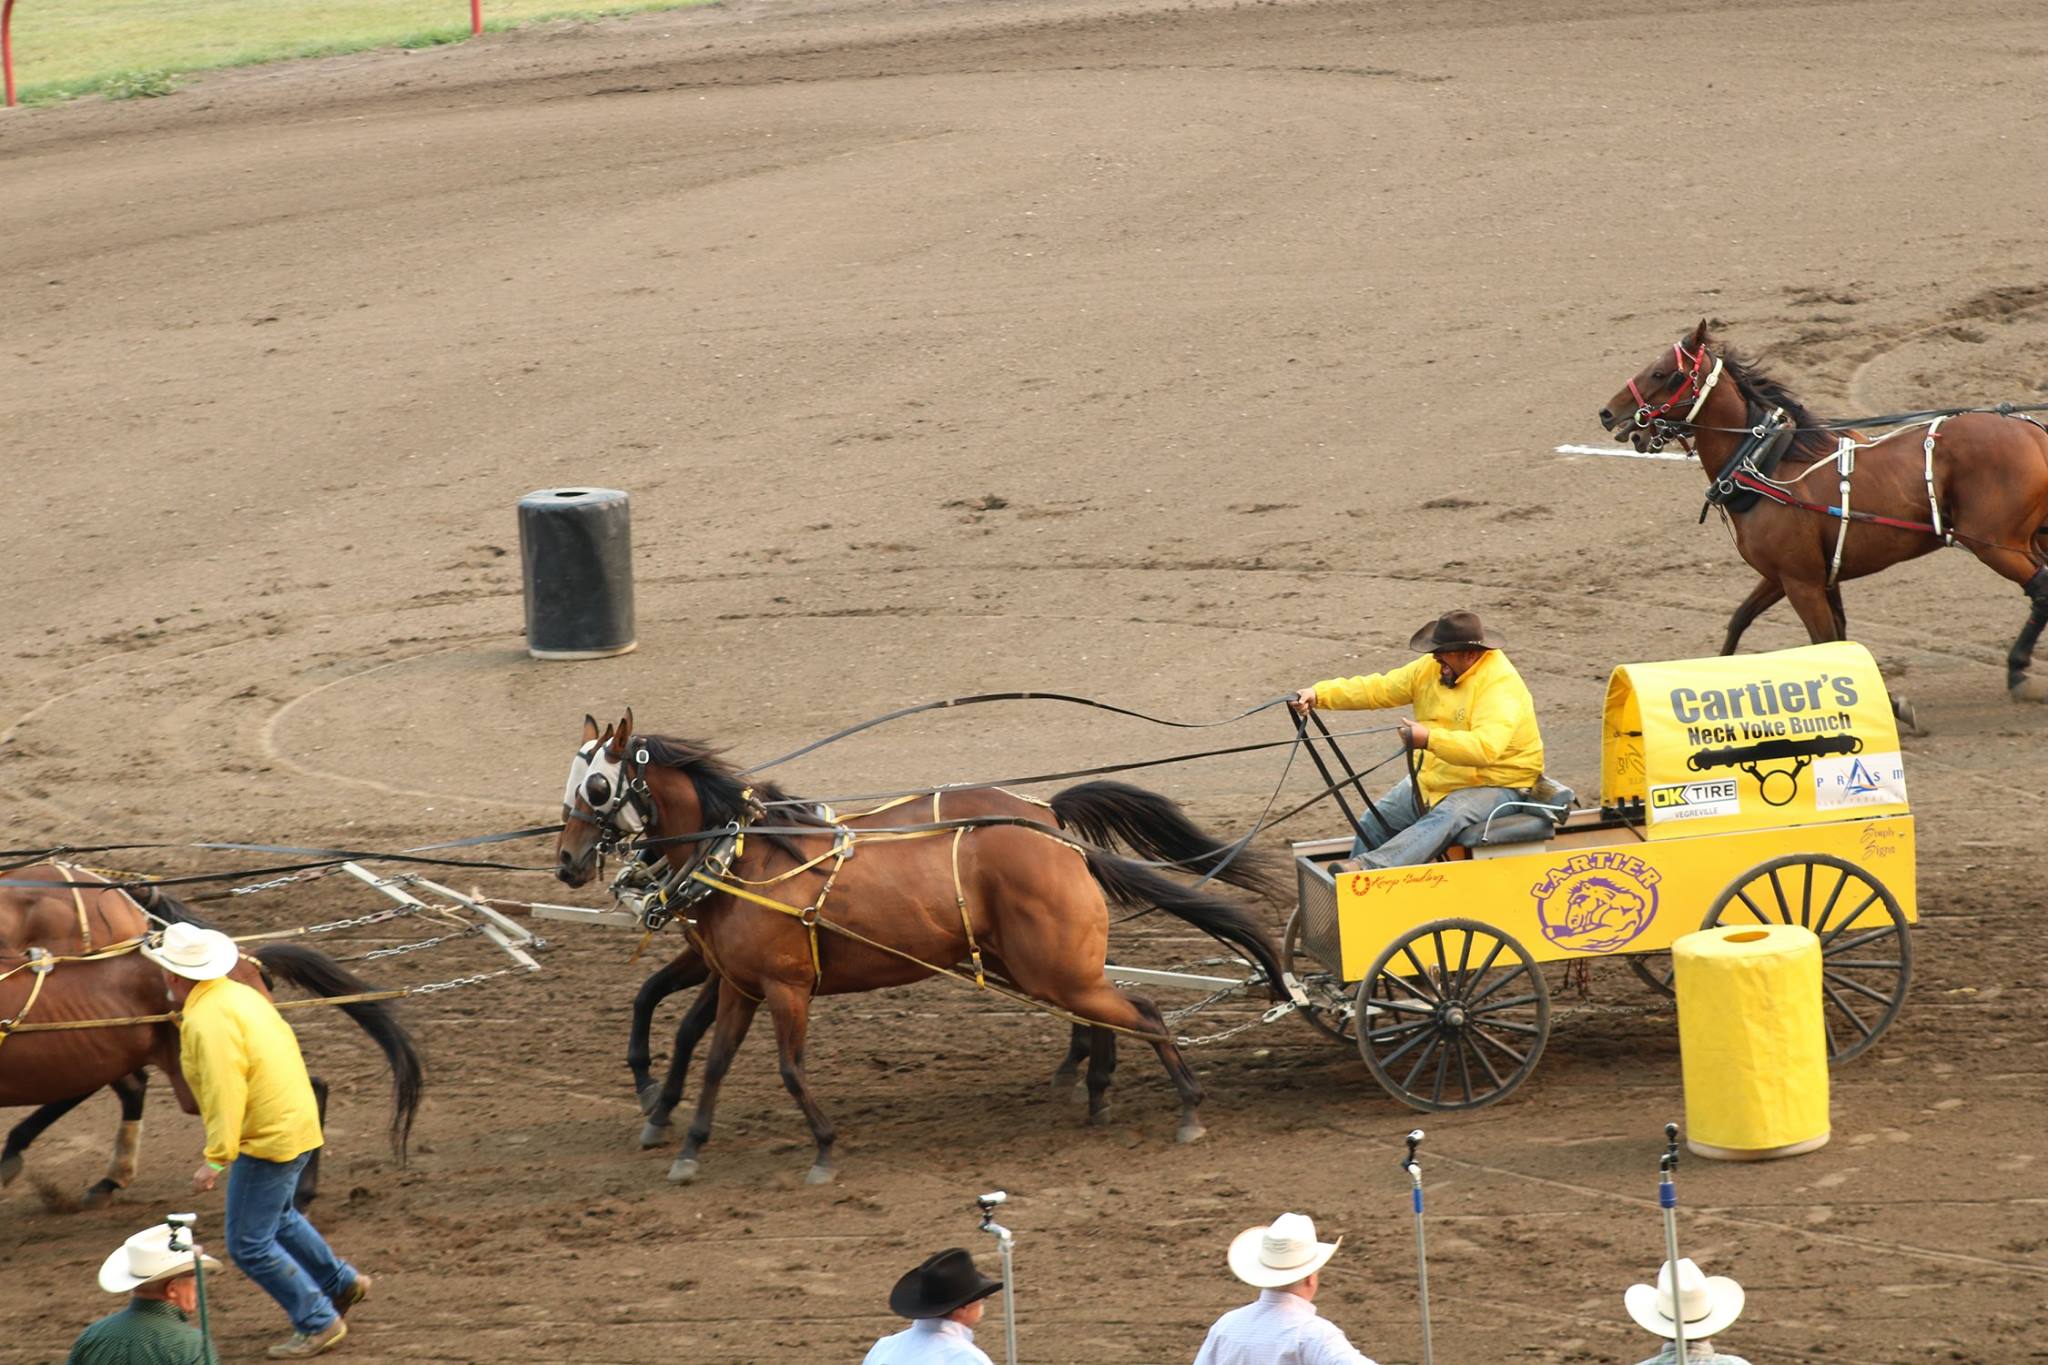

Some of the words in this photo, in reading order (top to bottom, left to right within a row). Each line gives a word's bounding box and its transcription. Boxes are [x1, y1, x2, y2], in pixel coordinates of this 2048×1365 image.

[1670, 674, 1858, 724] Cartier's
[1687, 724, 1736, 746] Neck
[1740, 718, 1785, 740] Yoke
[1789, 711, 1852, 735] Bunch
[1652, 785, 1688, 808] OK
[1692, 784, 1734, 800] TIRE
[1674, 807, 1719, 818] VEGREVILLE
[1530, 852, 1662, 900] CARTIER
